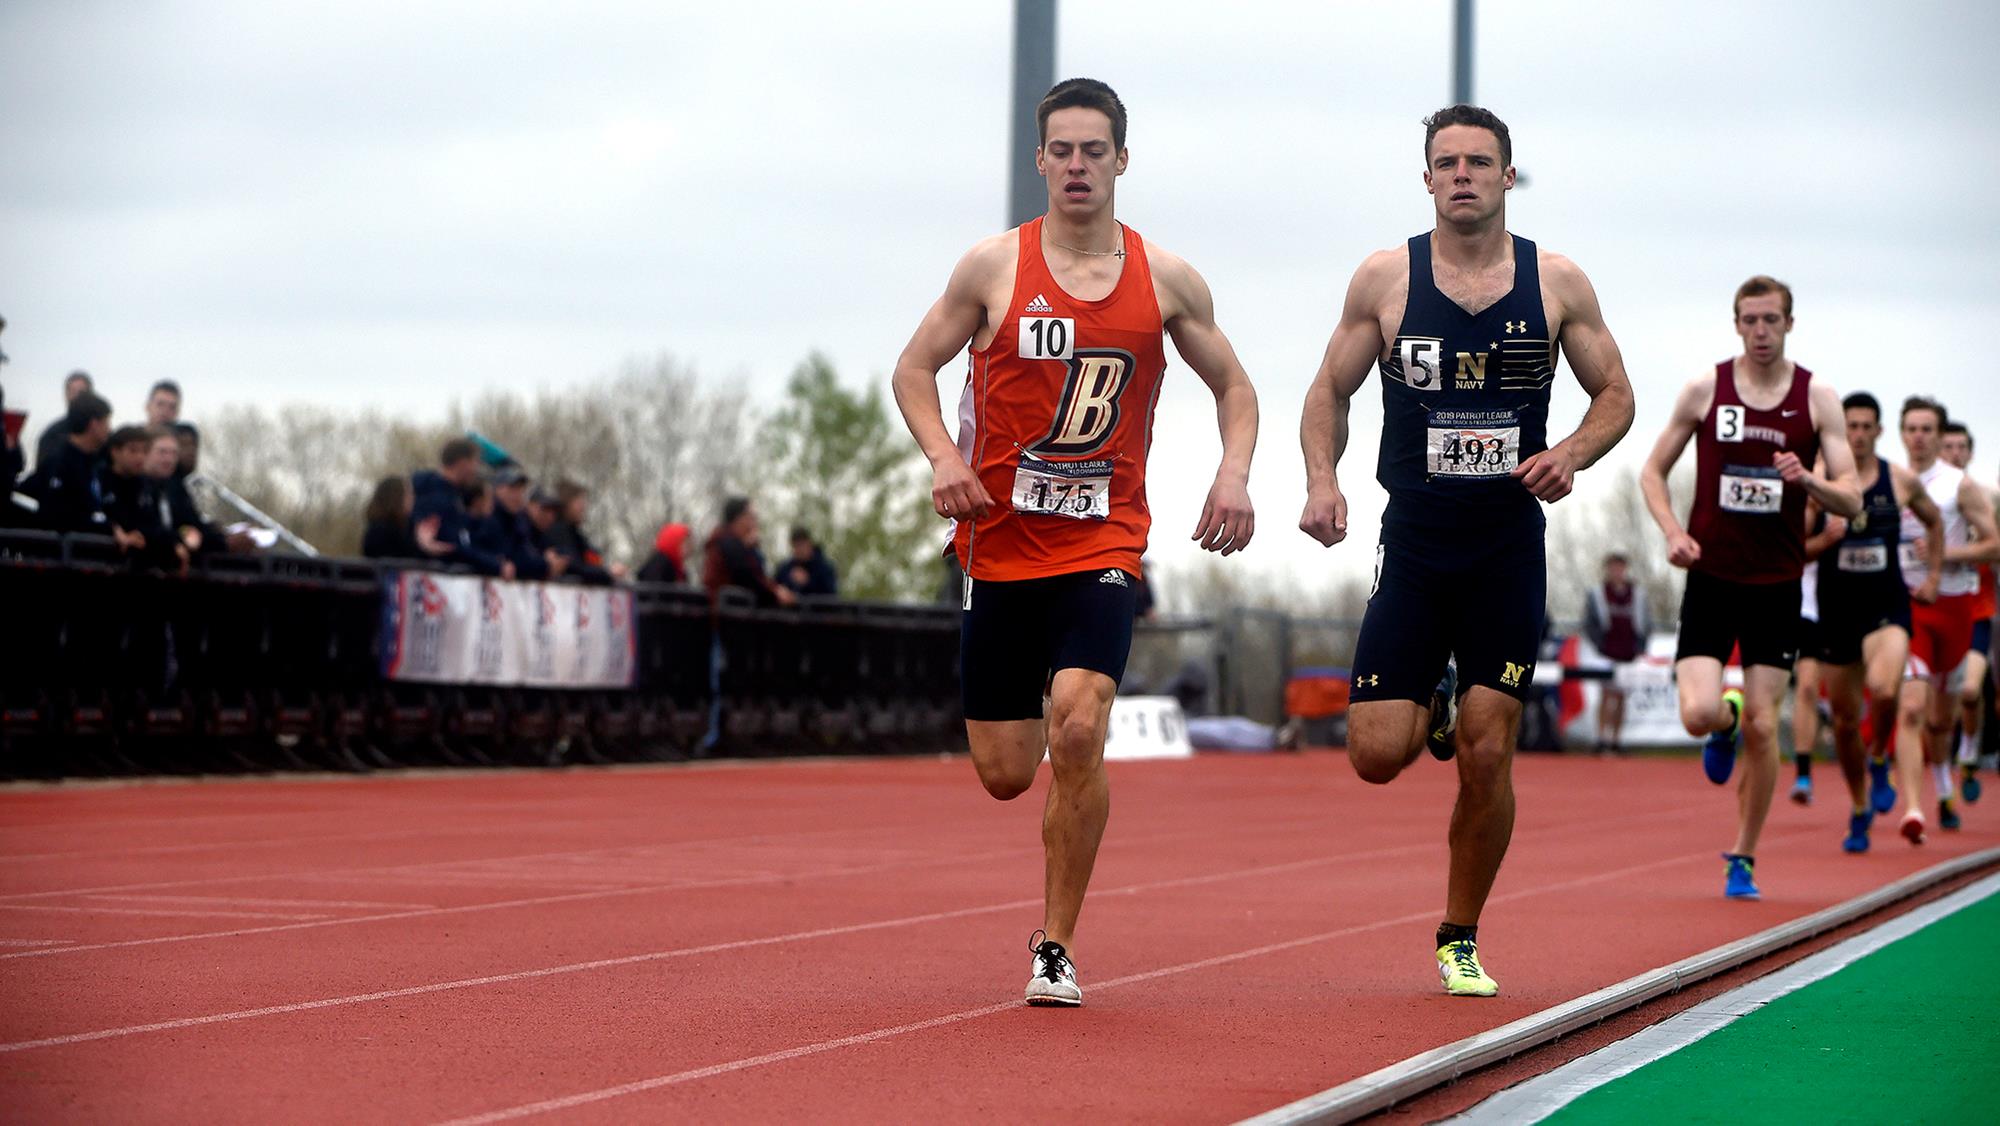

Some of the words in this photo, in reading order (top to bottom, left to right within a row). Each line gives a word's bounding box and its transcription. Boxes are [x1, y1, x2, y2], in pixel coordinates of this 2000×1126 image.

[1025, 305, 1053, 313] adidas
[1029, 319, 1067, 357] 10
[1411, 343, 1433, 388] 5
[1455, 352, 1489, 380] N
[1455, 380, 1485, 389] NAVY
[1029, 347, 1137, 457] B
[1436, 411, 1455, 420] 2019
[1455, 411, 1485, 420] PATRIOT
[1486, 410, 1513, 419] LEAGUE
[1722, 408, 1738, 438] 3
[1443, 438, 1504, 466] 493
[1034, 483, 1093, 512] 175
[1731, 482, 1771, 505] 325
[1500, 676, 1520, 688] NAVY
[1502, 661, 1525, 682] N
